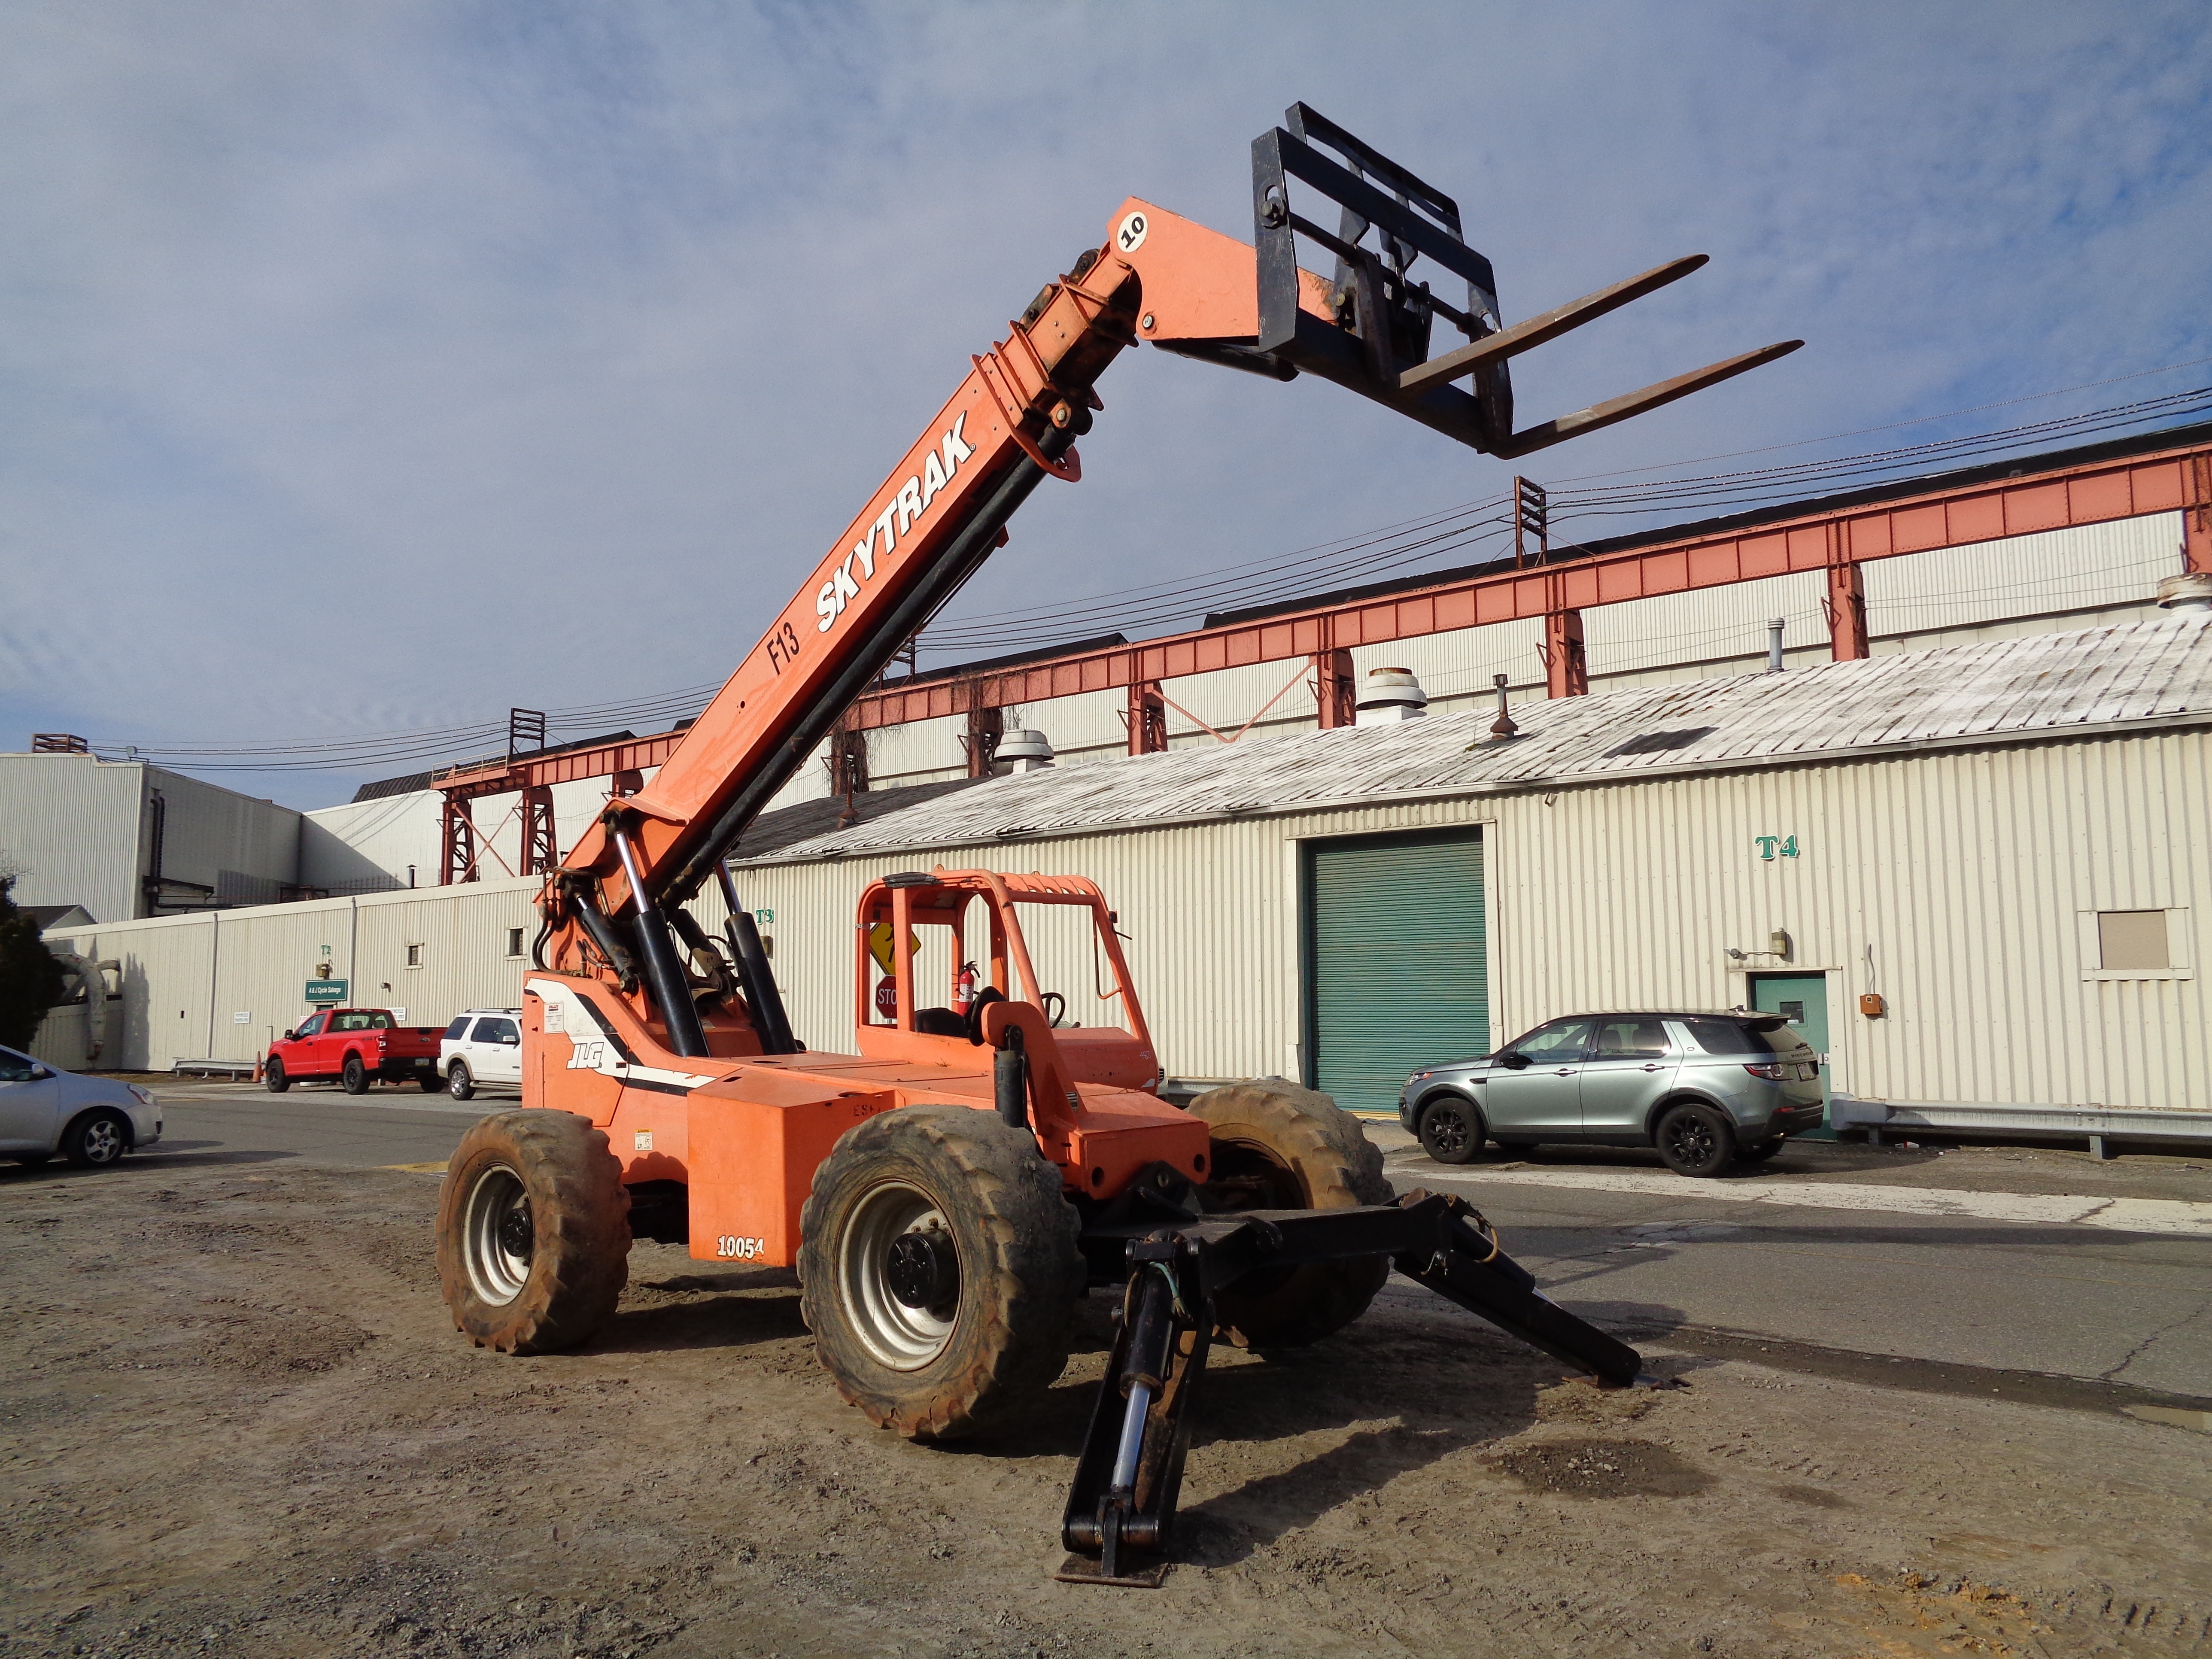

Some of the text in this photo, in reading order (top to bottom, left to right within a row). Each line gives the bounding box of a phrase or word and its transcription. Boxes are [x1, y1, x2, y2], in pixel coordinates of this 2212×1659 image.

[1121, 216, 1145, 249] 10
[816, 410, 972, 633] SKYTRAK
[766, 622, 799, 676] F13
[1754, 834, 1799, 860] T4
[755, 908, 774, 924] T3
[321, 945, 331, 955] T2
[878, 988, 896, 1005] STO
[566, 1042, 605, 1070] JLG
[717, 1235, 764, 1260] 10054
